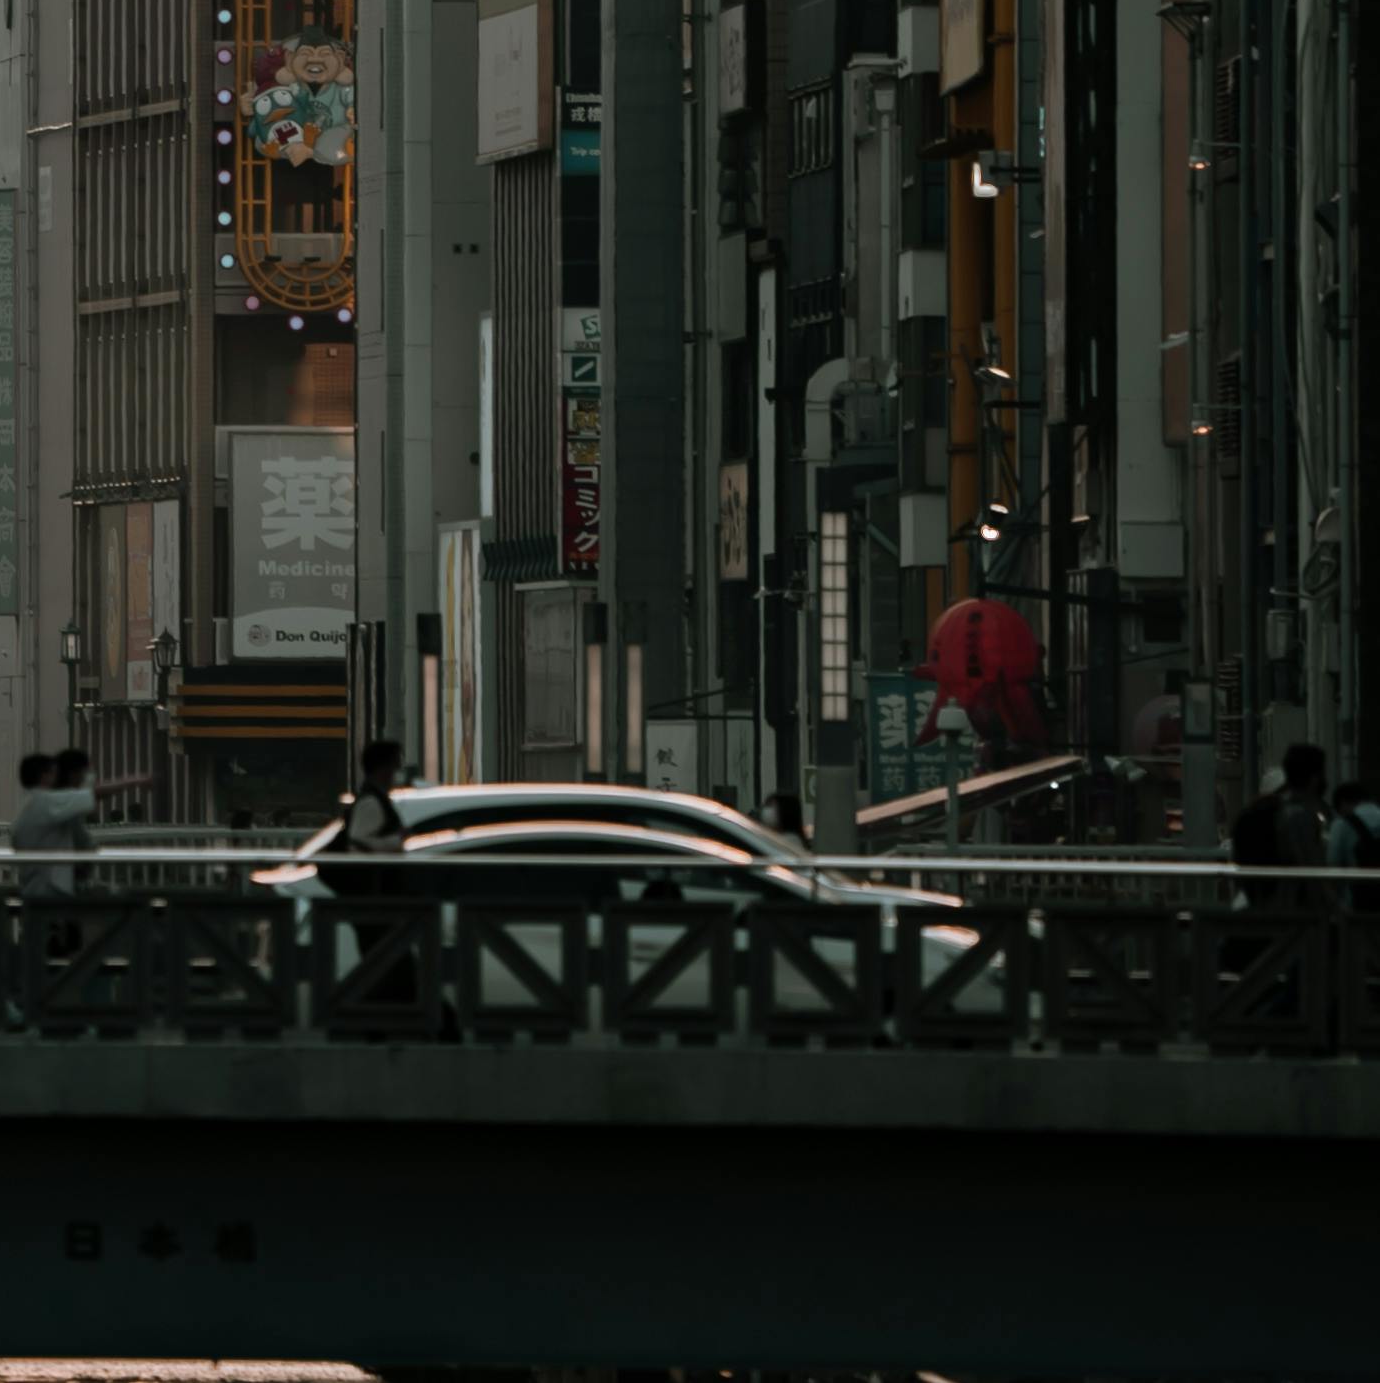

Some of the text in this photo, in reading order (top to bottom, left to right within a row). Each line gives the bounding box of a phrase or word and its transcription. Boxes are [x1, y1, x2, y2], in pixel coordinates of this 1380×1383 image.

[261, 456, 355, 551] 薬
[574, 466, 601, 553] コミック
[258, 560, 355, 577] Medicine
[275, 630, 305, 643] Don
